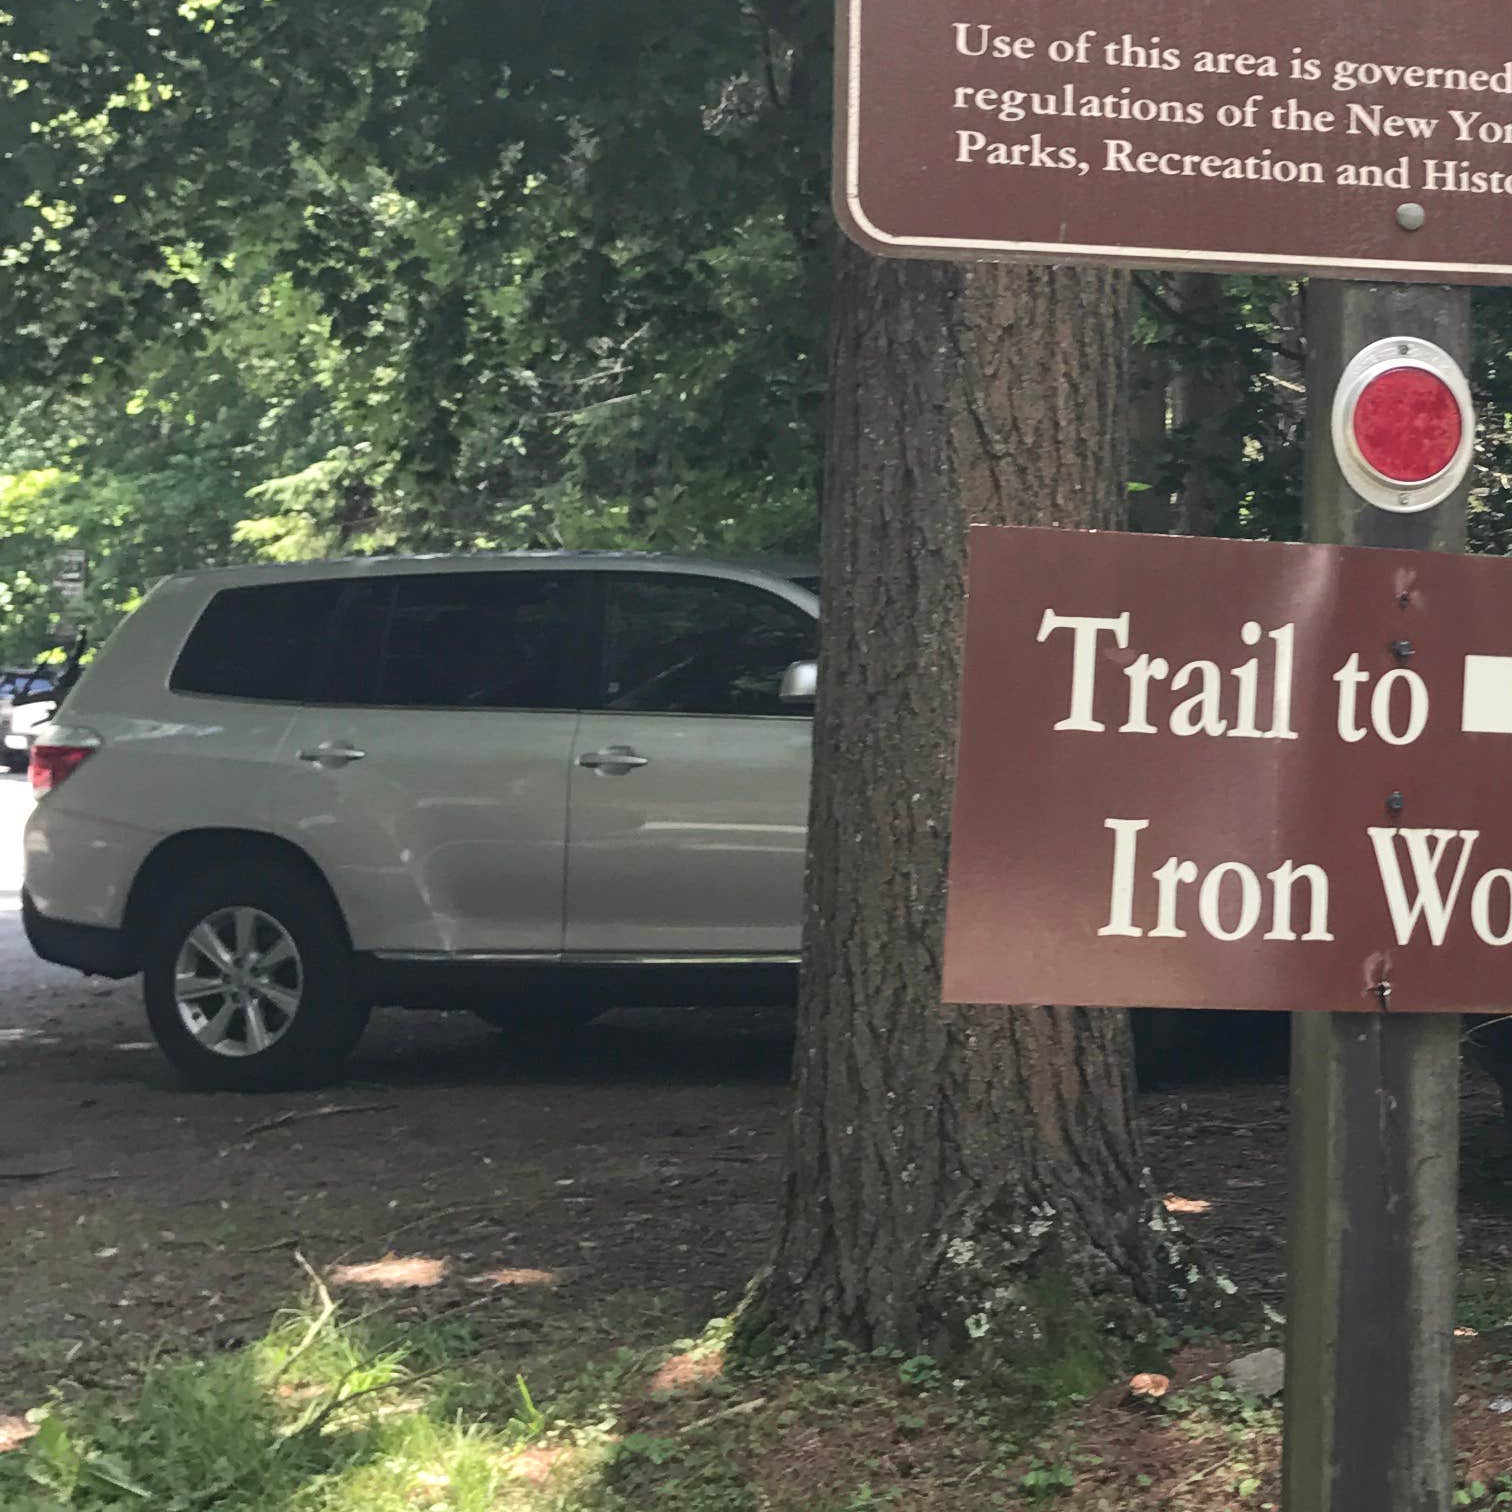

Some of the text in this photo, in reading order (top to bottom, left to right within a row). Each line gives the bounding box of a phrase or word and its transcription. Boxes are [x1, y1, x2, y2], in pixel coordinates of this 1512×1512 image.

[952, 23, 1035, 59] Use
[1048, 31, 1097, 63] of
[1104, 34, 1180, 70] this
[1194, 52, 1279, 76] area
[1290, 47, 1321, 80] is
[953, 84, 1204, 124] regulations
[1217, 95, 1263, 127] of
[1270, 99, 1335, 132] the
[1346, 104, 1439, 138] New
[956, 130, 1089, 176] Parks,
[1102, 140, 1325, 183] Recreation
[1336, 157, 1411, 189] and
[1037, 609, 1429, 745] Trail to
[1098, 818, 1334, 941] Iron
